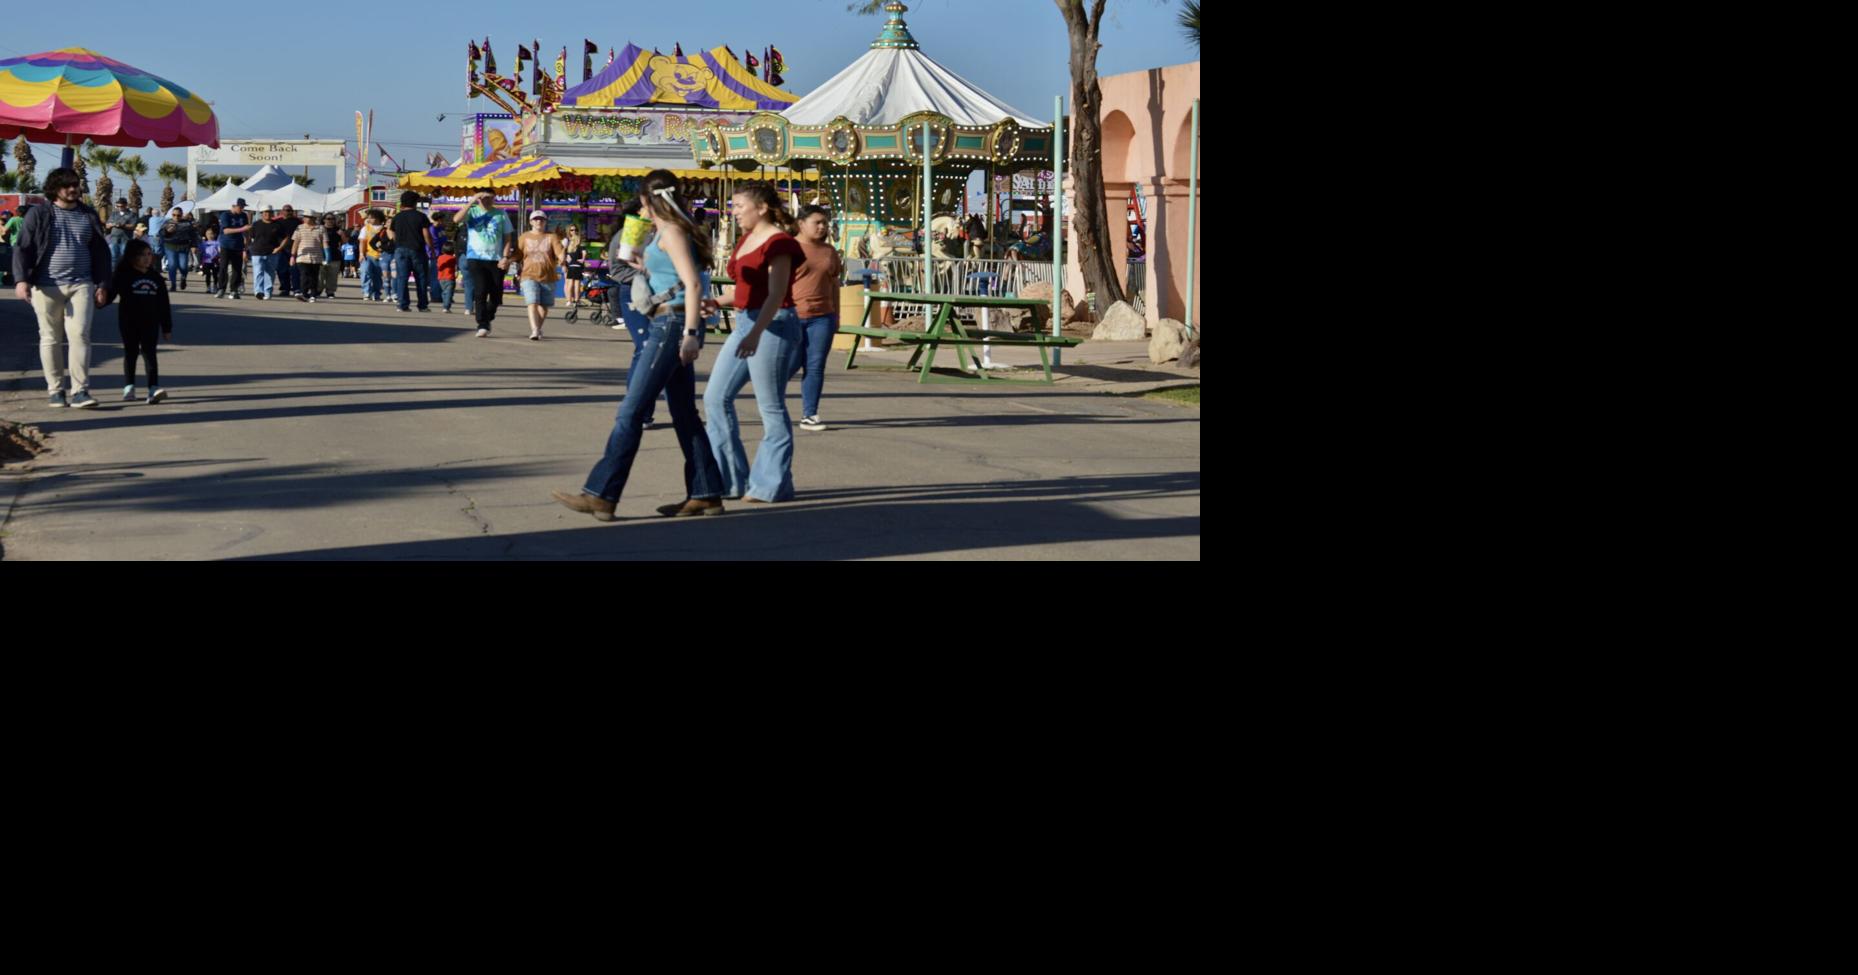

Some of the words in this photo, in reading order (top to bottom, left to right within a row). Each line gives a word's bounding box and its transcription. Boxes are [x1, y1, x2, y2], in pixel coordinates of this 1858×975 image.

[563, 113, 649, 136] Water
[231, 143, 265, 152] Come
[269, 143, 298, 152] Back
[248, 153, 283, 161] Soon!
